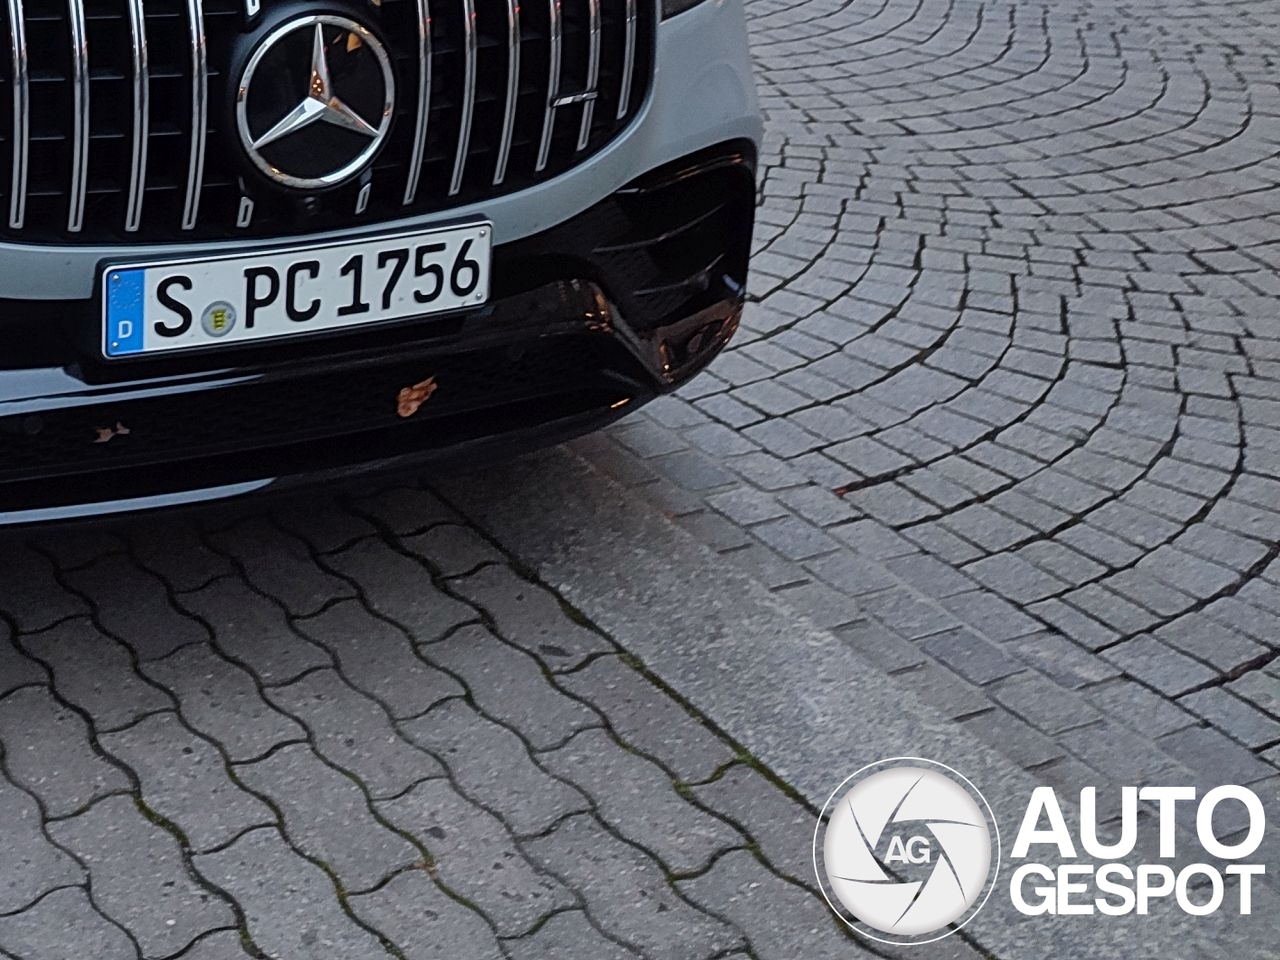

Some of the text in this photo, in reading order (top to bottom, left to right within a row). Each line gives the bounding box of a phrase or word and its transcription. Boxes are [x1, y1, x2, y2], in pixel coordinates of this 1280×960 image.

[153, 238, 481, 338] S PC 1756
[118, 320, 132, 339] D
